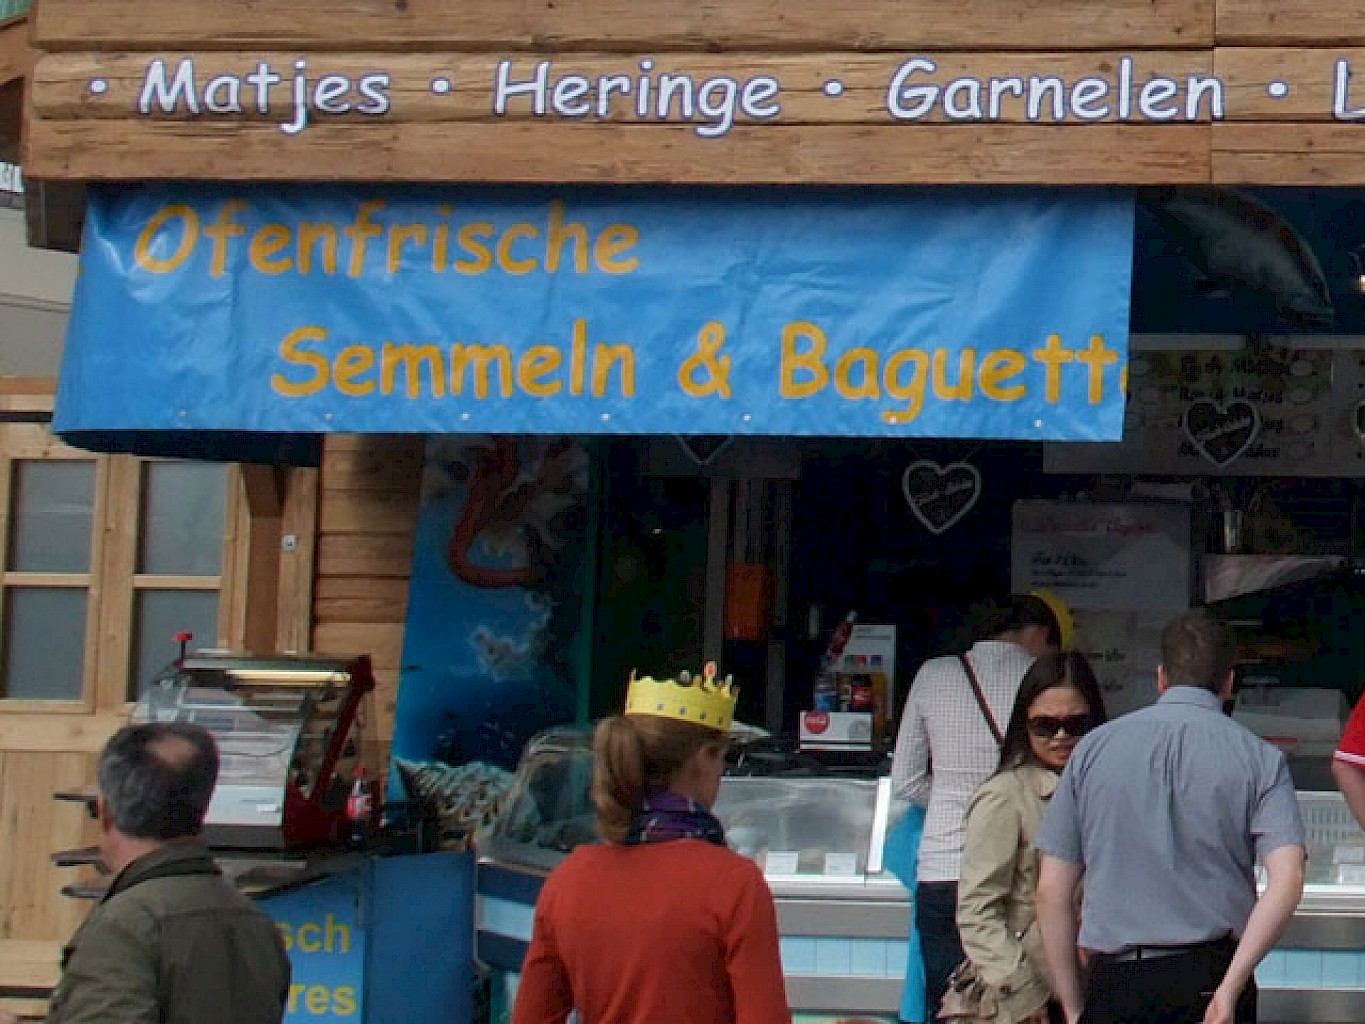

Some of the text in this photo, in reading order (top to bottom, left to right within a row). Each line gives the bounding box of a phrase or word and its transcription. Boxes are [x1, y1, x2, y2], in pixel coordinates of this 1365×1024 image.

[137, 57, 391, 136] Matjes
[493, 58, 781, 139] Heringe
[885, 56, 1226, 122] Garnelen
[134, 199, 641, 276] Ofenfrische
[271, 319, 1127, 423] Semmeln & Baguett
